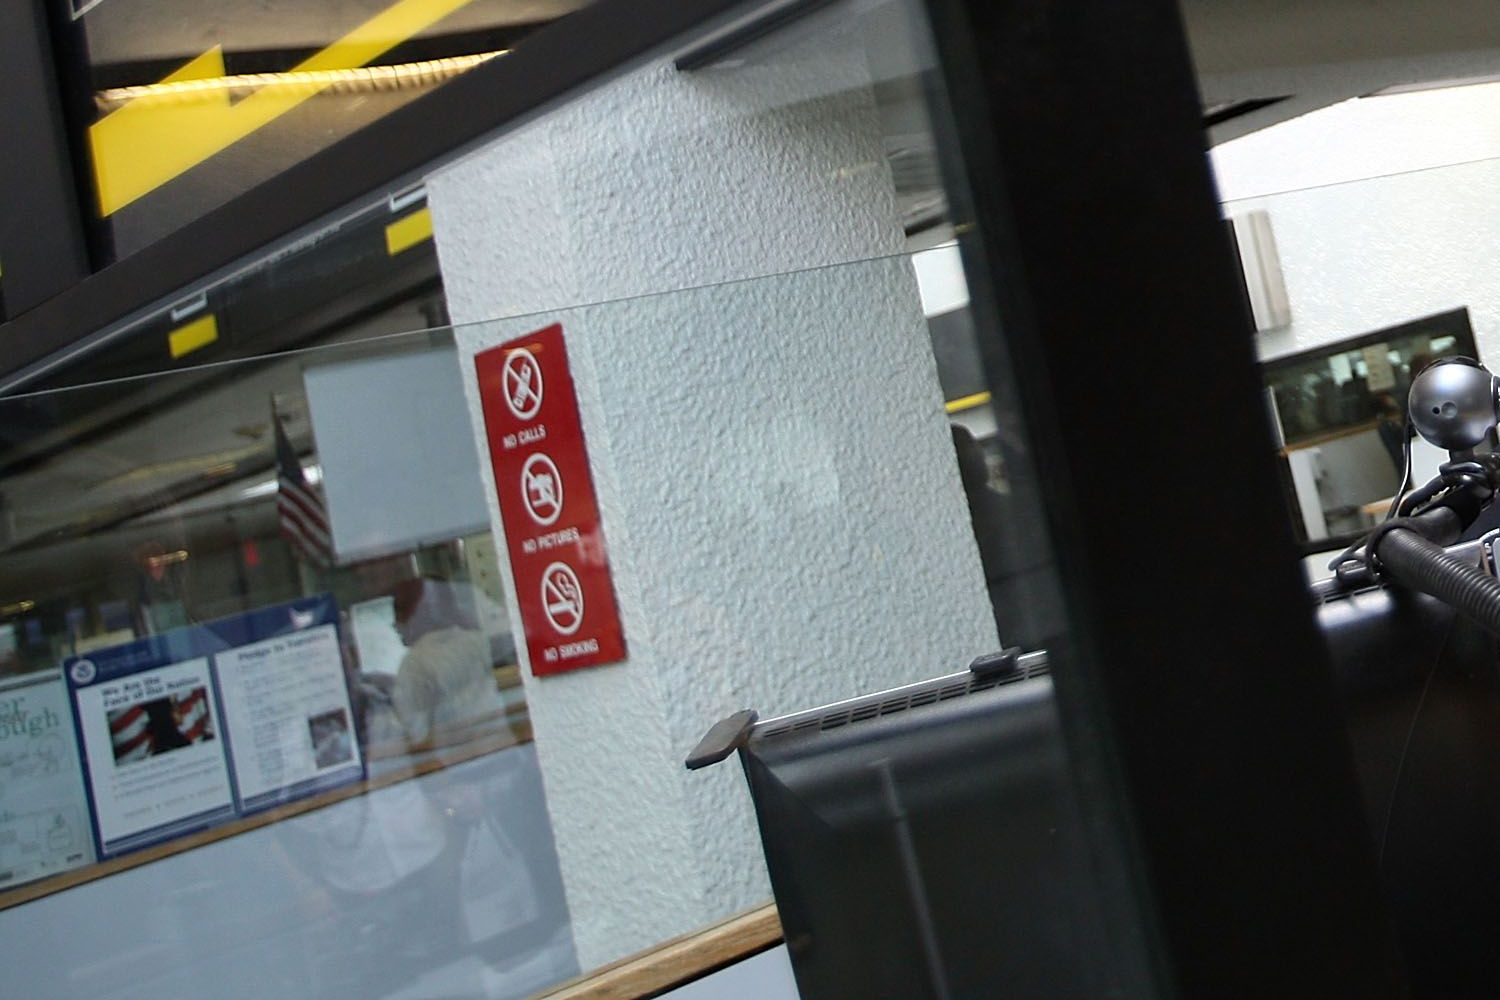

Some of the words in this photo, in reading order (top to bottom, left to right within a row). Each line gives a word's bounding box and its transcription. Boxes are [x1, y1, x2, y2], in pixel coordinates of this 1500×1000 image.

[503, 433, 517, 449] NO
[518, 424, 546, 445] CALLS
[522, 538, 537, 553] NO
[538, 526, 580, 549] PICTURES
[543, 647, 558, 662] NO
[559, 638, 599, 660] SMOKING
